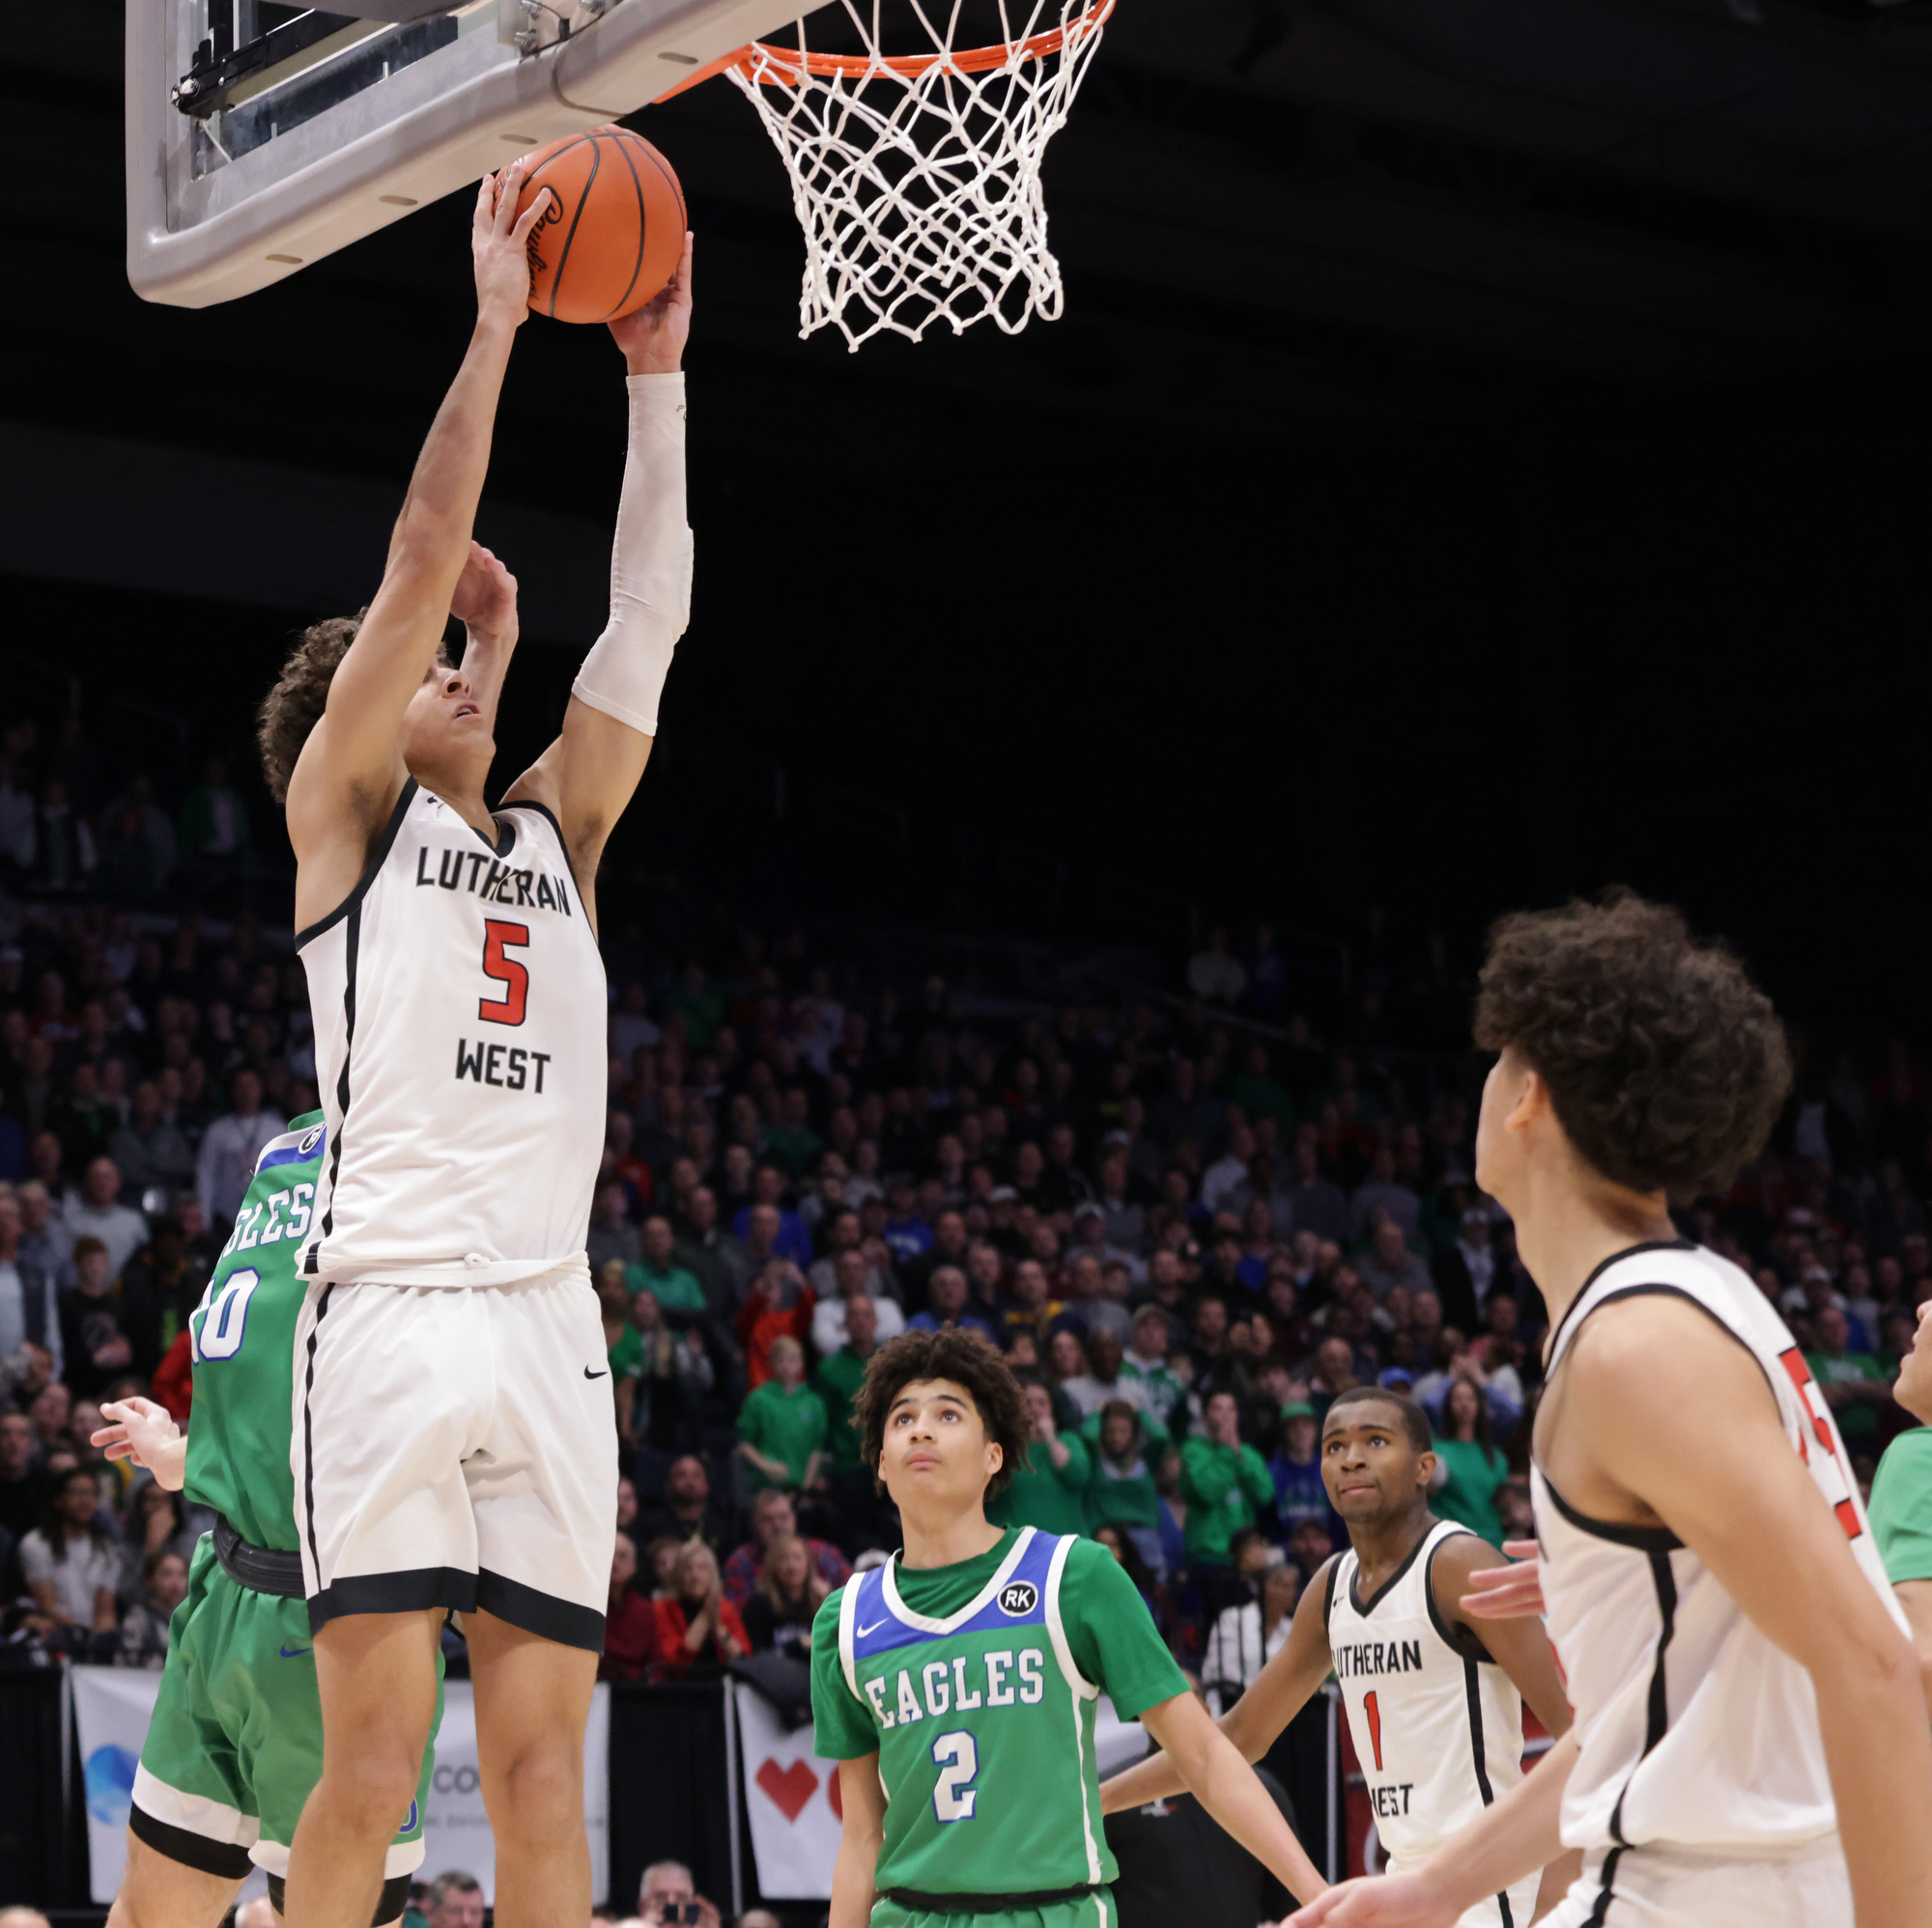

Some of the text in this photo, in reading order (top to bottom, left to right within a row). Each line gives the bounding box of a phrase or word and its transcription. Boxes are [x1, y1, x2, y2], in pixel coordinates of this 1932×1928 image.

[415, 846, 572, 917] LUTHERAN
[477, 918, 530, 1027] 5
[455, 1037, 552, 1094] WEST
[218, 1181, 316, 1264] GLES
[1005, 1588, 1032, 1608] RK
[864, 1648, 1044, 1730] EAGLES
[1363, 1690, 1383, 1772] 1
[930, 1728, 980, 1824] 2
